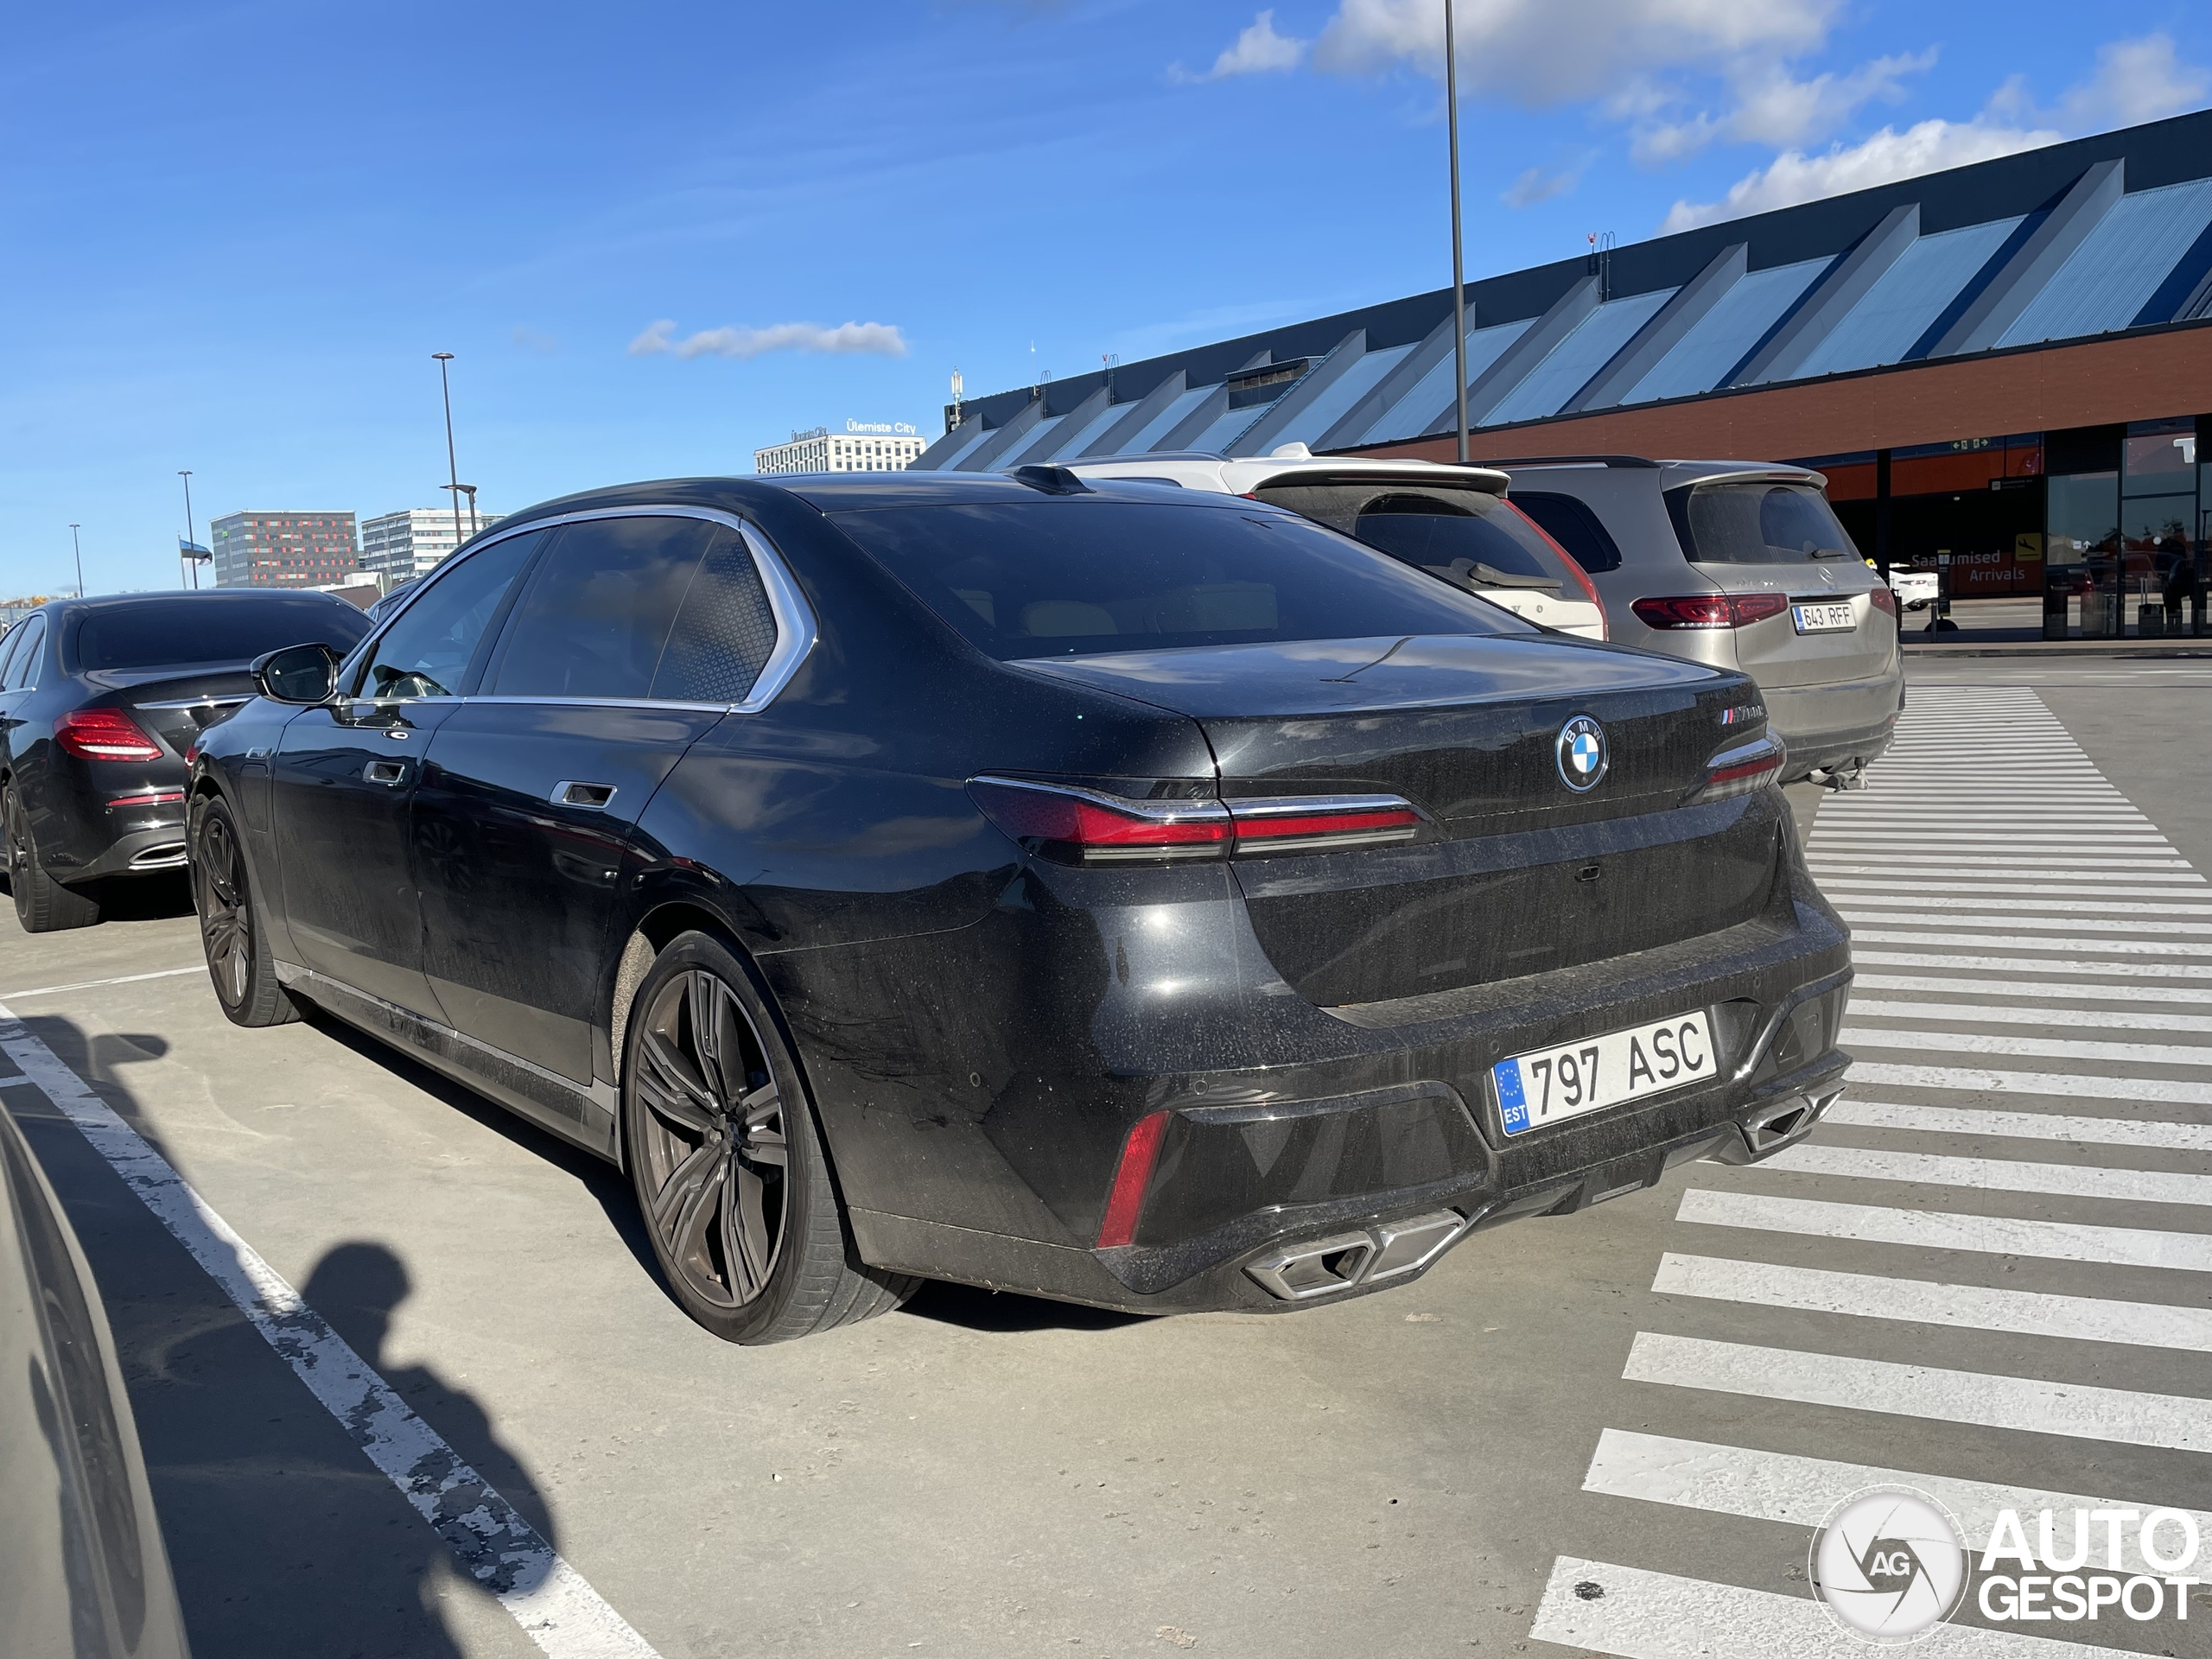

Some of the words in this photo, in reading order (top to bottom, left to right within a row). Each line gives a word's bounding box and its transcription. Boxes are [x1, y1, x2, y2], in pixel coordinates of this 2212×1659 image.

[846, 417, 892, 433] Ülemiste
[894, 422, 916, 435] City
[1911, 550, 2000, 567] Saaumised
[1969, 567, 2025, 582] Arrivals
[1803, 607, 1824, 626] 643
[1827, 607, 1850, 625] RFF
[1565, 721, 1602, 744] BMW
[1530, 1046, 1599, 1116] 797
[1628, 1021, 1704, 1091] ASC
[1503, 1103, 1527, 1124] EST
